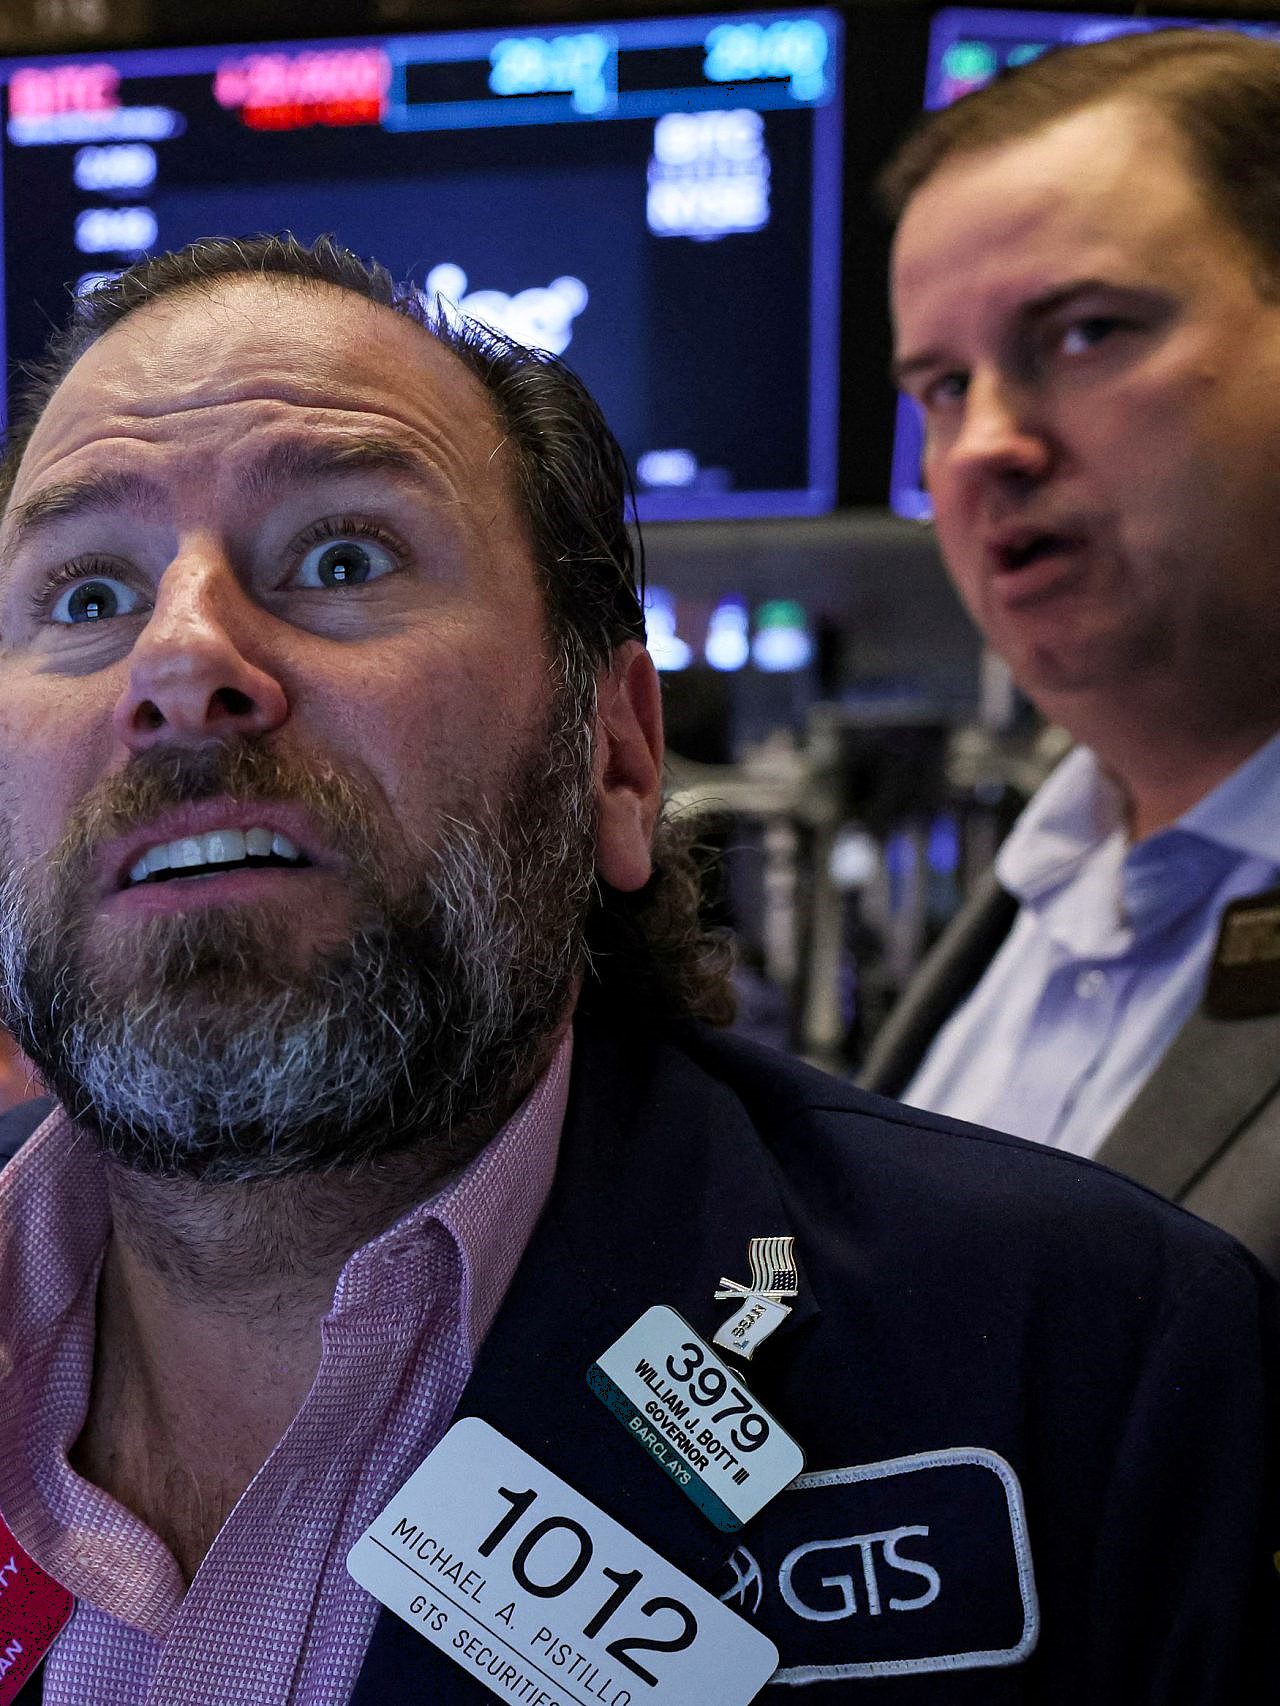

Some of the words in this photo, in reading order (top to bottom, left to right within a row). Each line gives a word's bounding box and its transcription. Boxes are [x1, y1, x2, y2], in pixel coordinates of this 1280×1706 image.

[634, 1358, 688, 1421] WILLIAM
[684, 1418, 701, 1434] J.
[696, 1429, 739, 1471] BOTT
[731, 1467, 751, 1486] III
[644, 1400, 710, 1472] GOVERNOR
[665, 1342, 770, 1453] 3979
[628, 1416, 692, 1485] BARCLAYS
[391, 1517, 488, 1605] MICHAEL
[494, 1601, 516, 1631] A.
[409, 1595, 448, 1632] GTS
[477, 1486, 699, 1688] 1012
[778, 1525, 942, 1622] GTS
